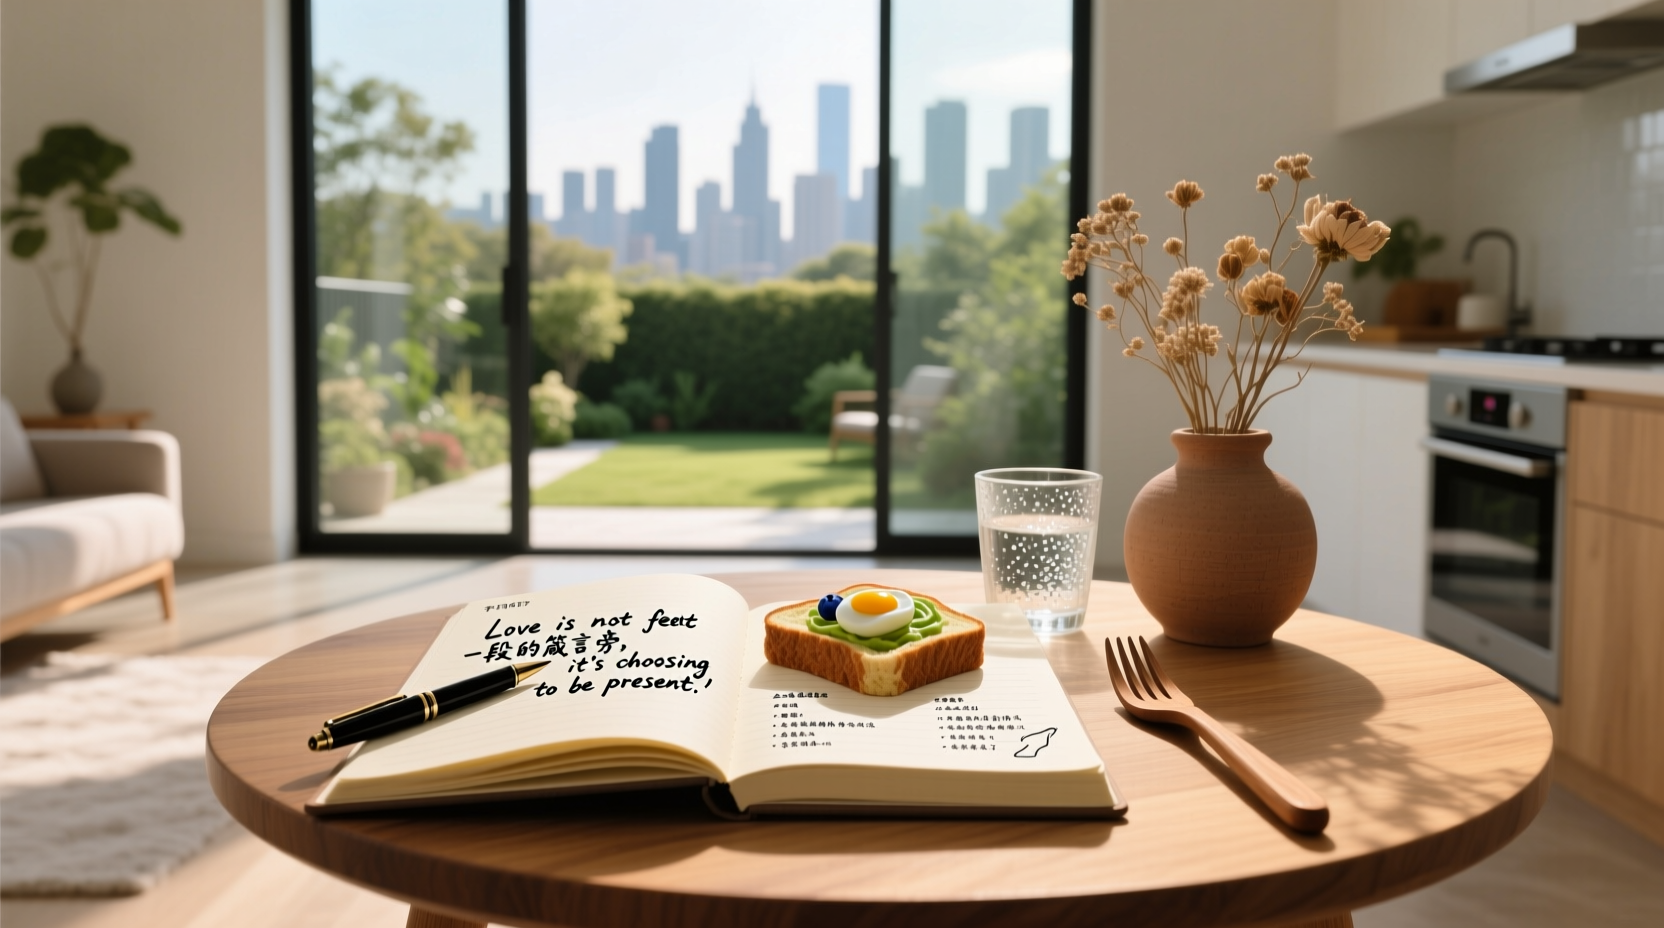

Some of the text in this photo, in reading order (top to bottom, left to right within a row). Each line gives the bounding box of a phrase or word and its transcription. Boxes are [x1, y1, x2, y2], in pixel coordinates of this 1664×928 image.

[484, 618, 541, 640] Love
[555, 616, 576, 632] is
[590, 611, 633, 628] not
[567, 650, 710, 680] it's choosing
[533, 681, 558, 698] to
[568, 675, 595, 694] be
